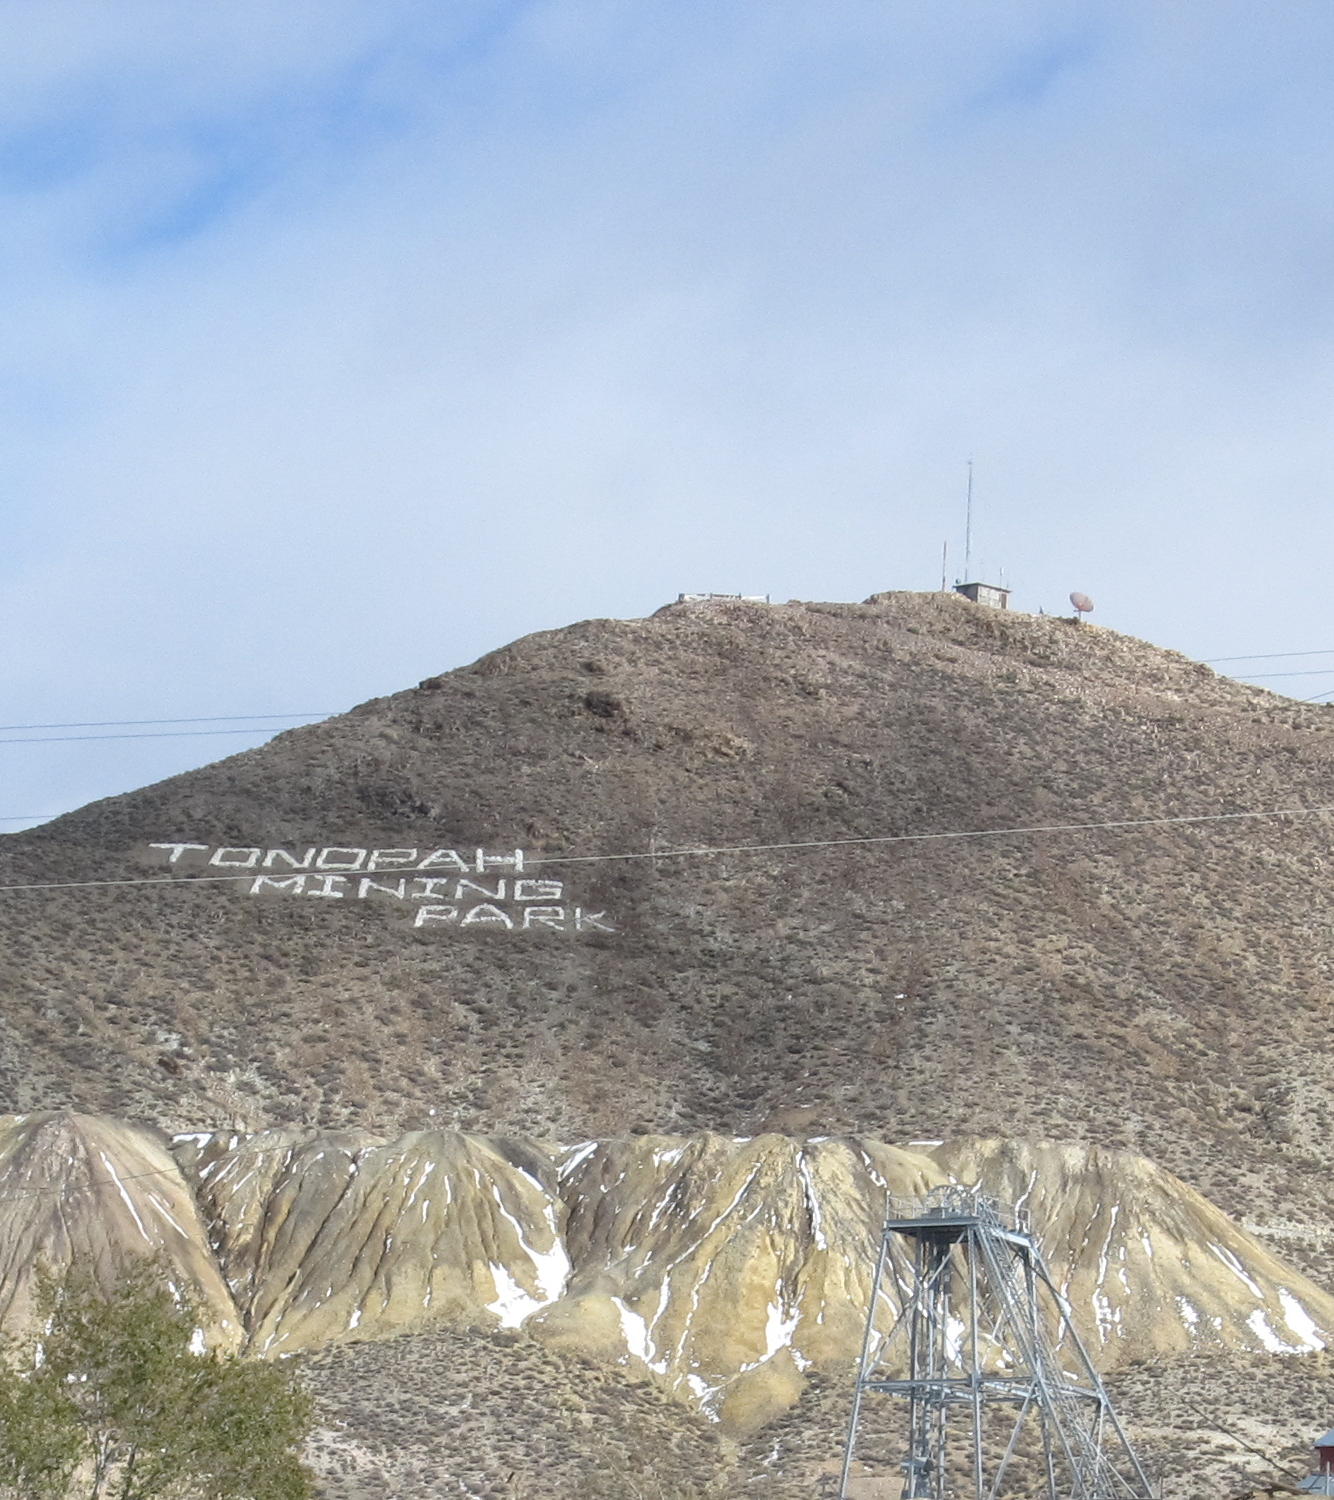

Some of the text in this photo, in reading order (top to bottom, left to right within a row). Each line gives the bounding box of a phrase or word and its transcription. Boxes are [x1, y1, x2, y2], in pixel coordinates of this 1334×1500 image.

[148, 842, 524, 873] TONOPAH
[249, 875, 564, 900] MINING
[414, 903, 616, 931] PARK
